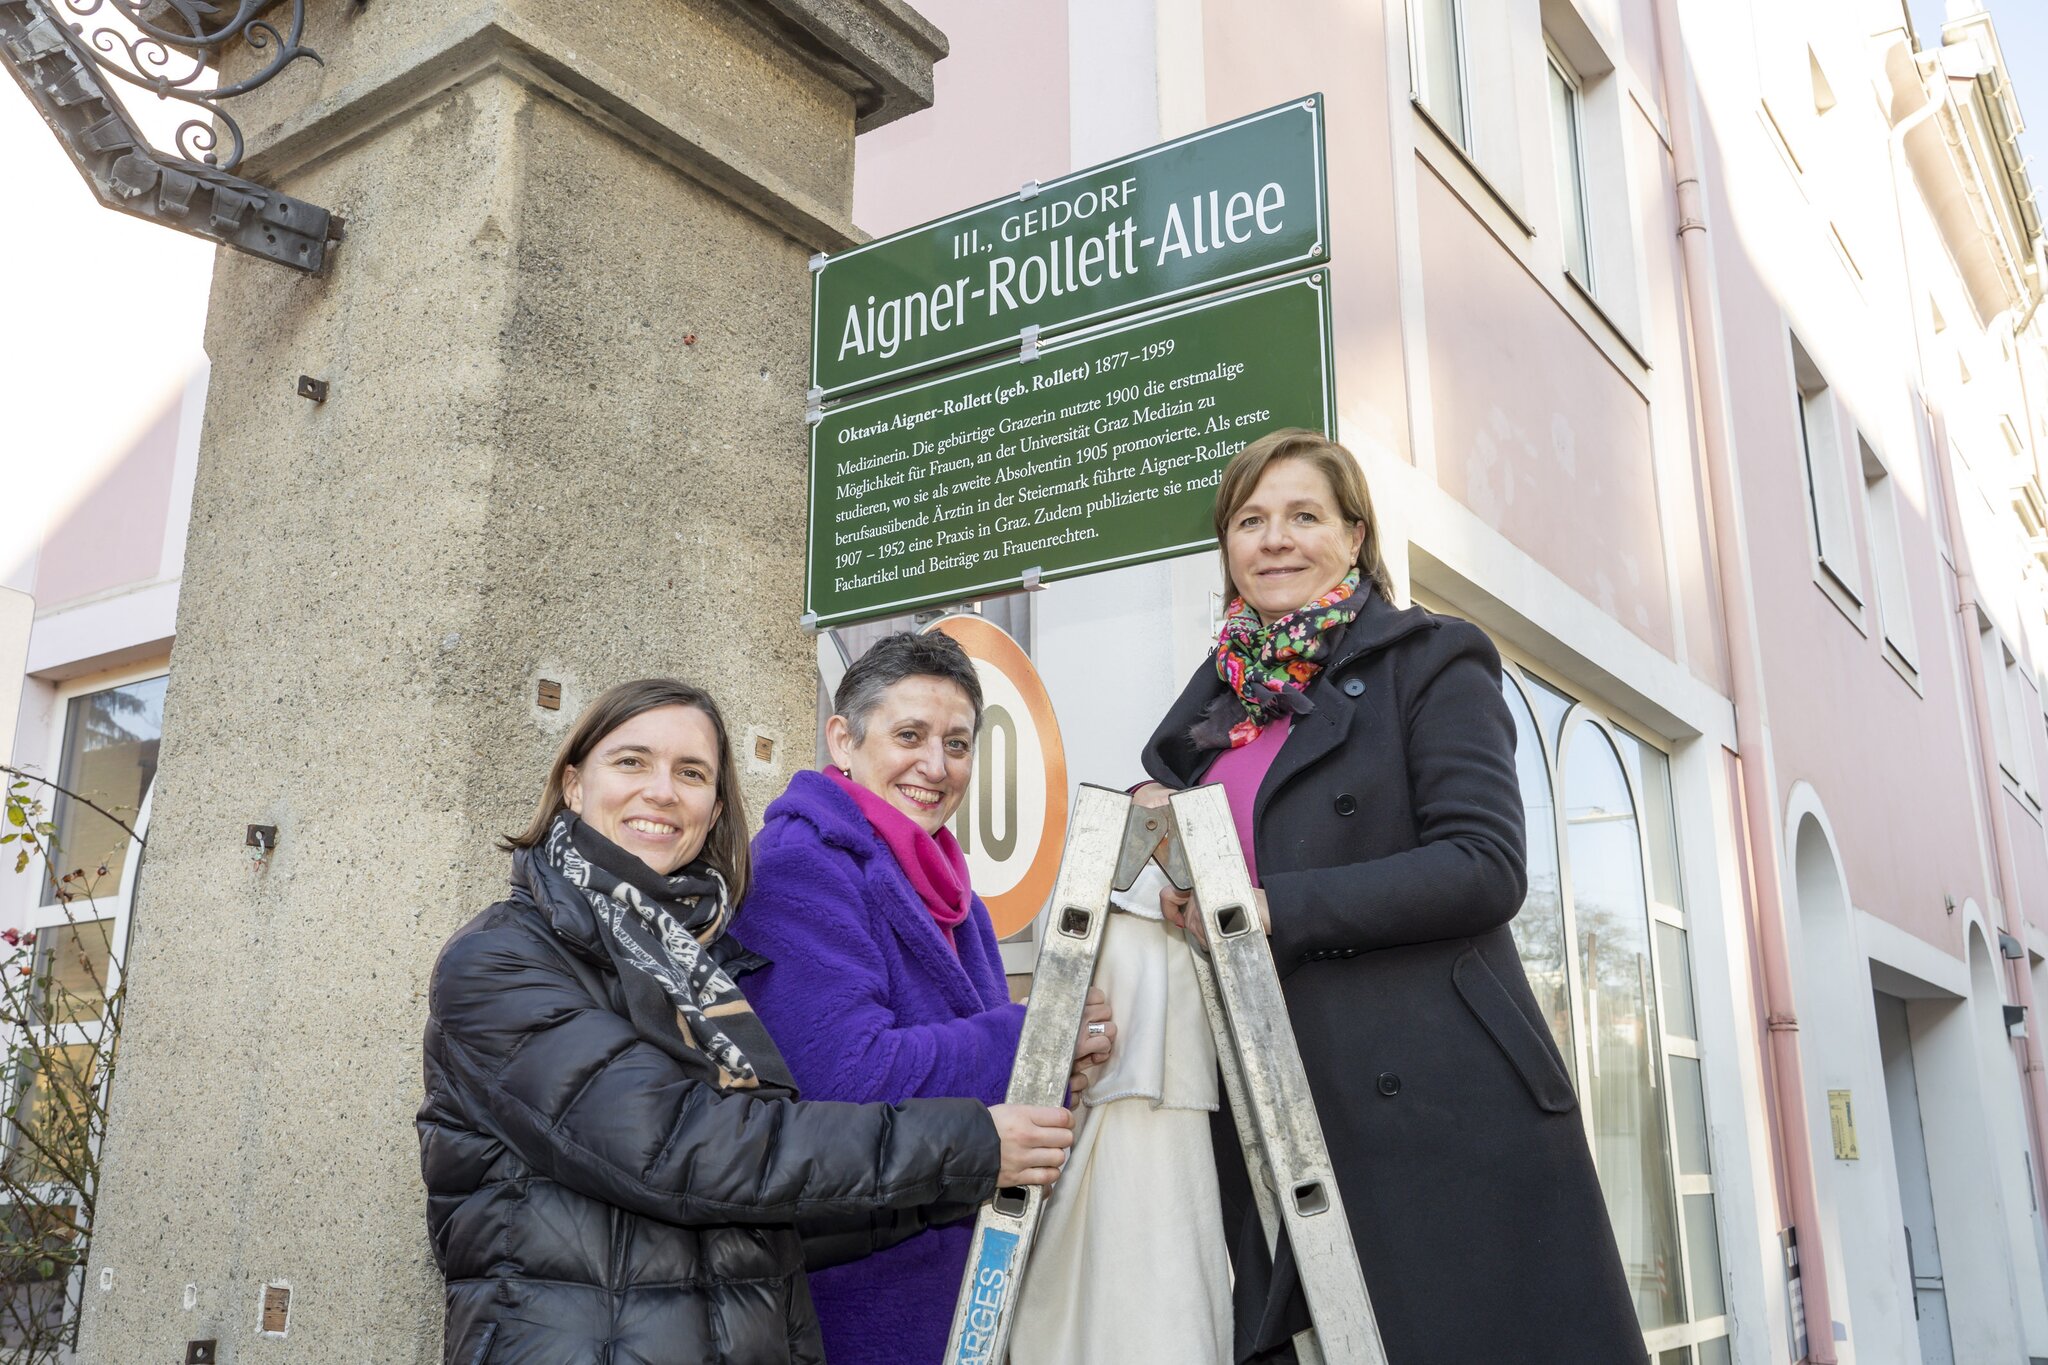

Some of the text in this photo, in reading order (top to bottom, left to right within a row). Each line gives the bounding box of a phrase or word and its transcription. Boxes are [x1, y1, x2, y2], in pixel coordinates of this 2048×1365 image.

[953, 177, 1137, 260] III., GEIDORF
[837, 181, 1286, 362] Aigner-Rollett-Allee
[835, 396, 1216, 501] Möglichkeit für Frauen, an der Universität Graz Medizin zu
[836, 362, 1245, 478] Medizinerin. Die gebürtige Grazerin nutzte 1900 die erstmalige
[837, 420, 889, 444] Oktavia
[889, 391, 993, 431] Aigner-Rollett
[994, 379, 1029, 405] (geb.
[1032, 361, 1090, 392] Rollett)
[835, 409, 1271, 523] studieren, wo sie als zweite Absolventin 1905 promovierte. Als erste
[835, 439, 1249, 546] berufsausübende Ärztin in der Steiermark führte Aigner-Rollett
[834, 527, 1099, 593] Fachartikel und Beiträge zu Frauenrechten.
[835, 549, 863, 569] 1907
[878, 540, 905, 560] 1952
[908, 537, 933, 553] eine
[936, 526, 975, 547] Praxis
[978, 523, 991, 537] in
[994, 516, 1031, 533] Graz.
[1034, 503, 1083, 525] Zudem
[1086, 487, 1160, 519] publizierte
[1163, 479, 1183, 497] sie
